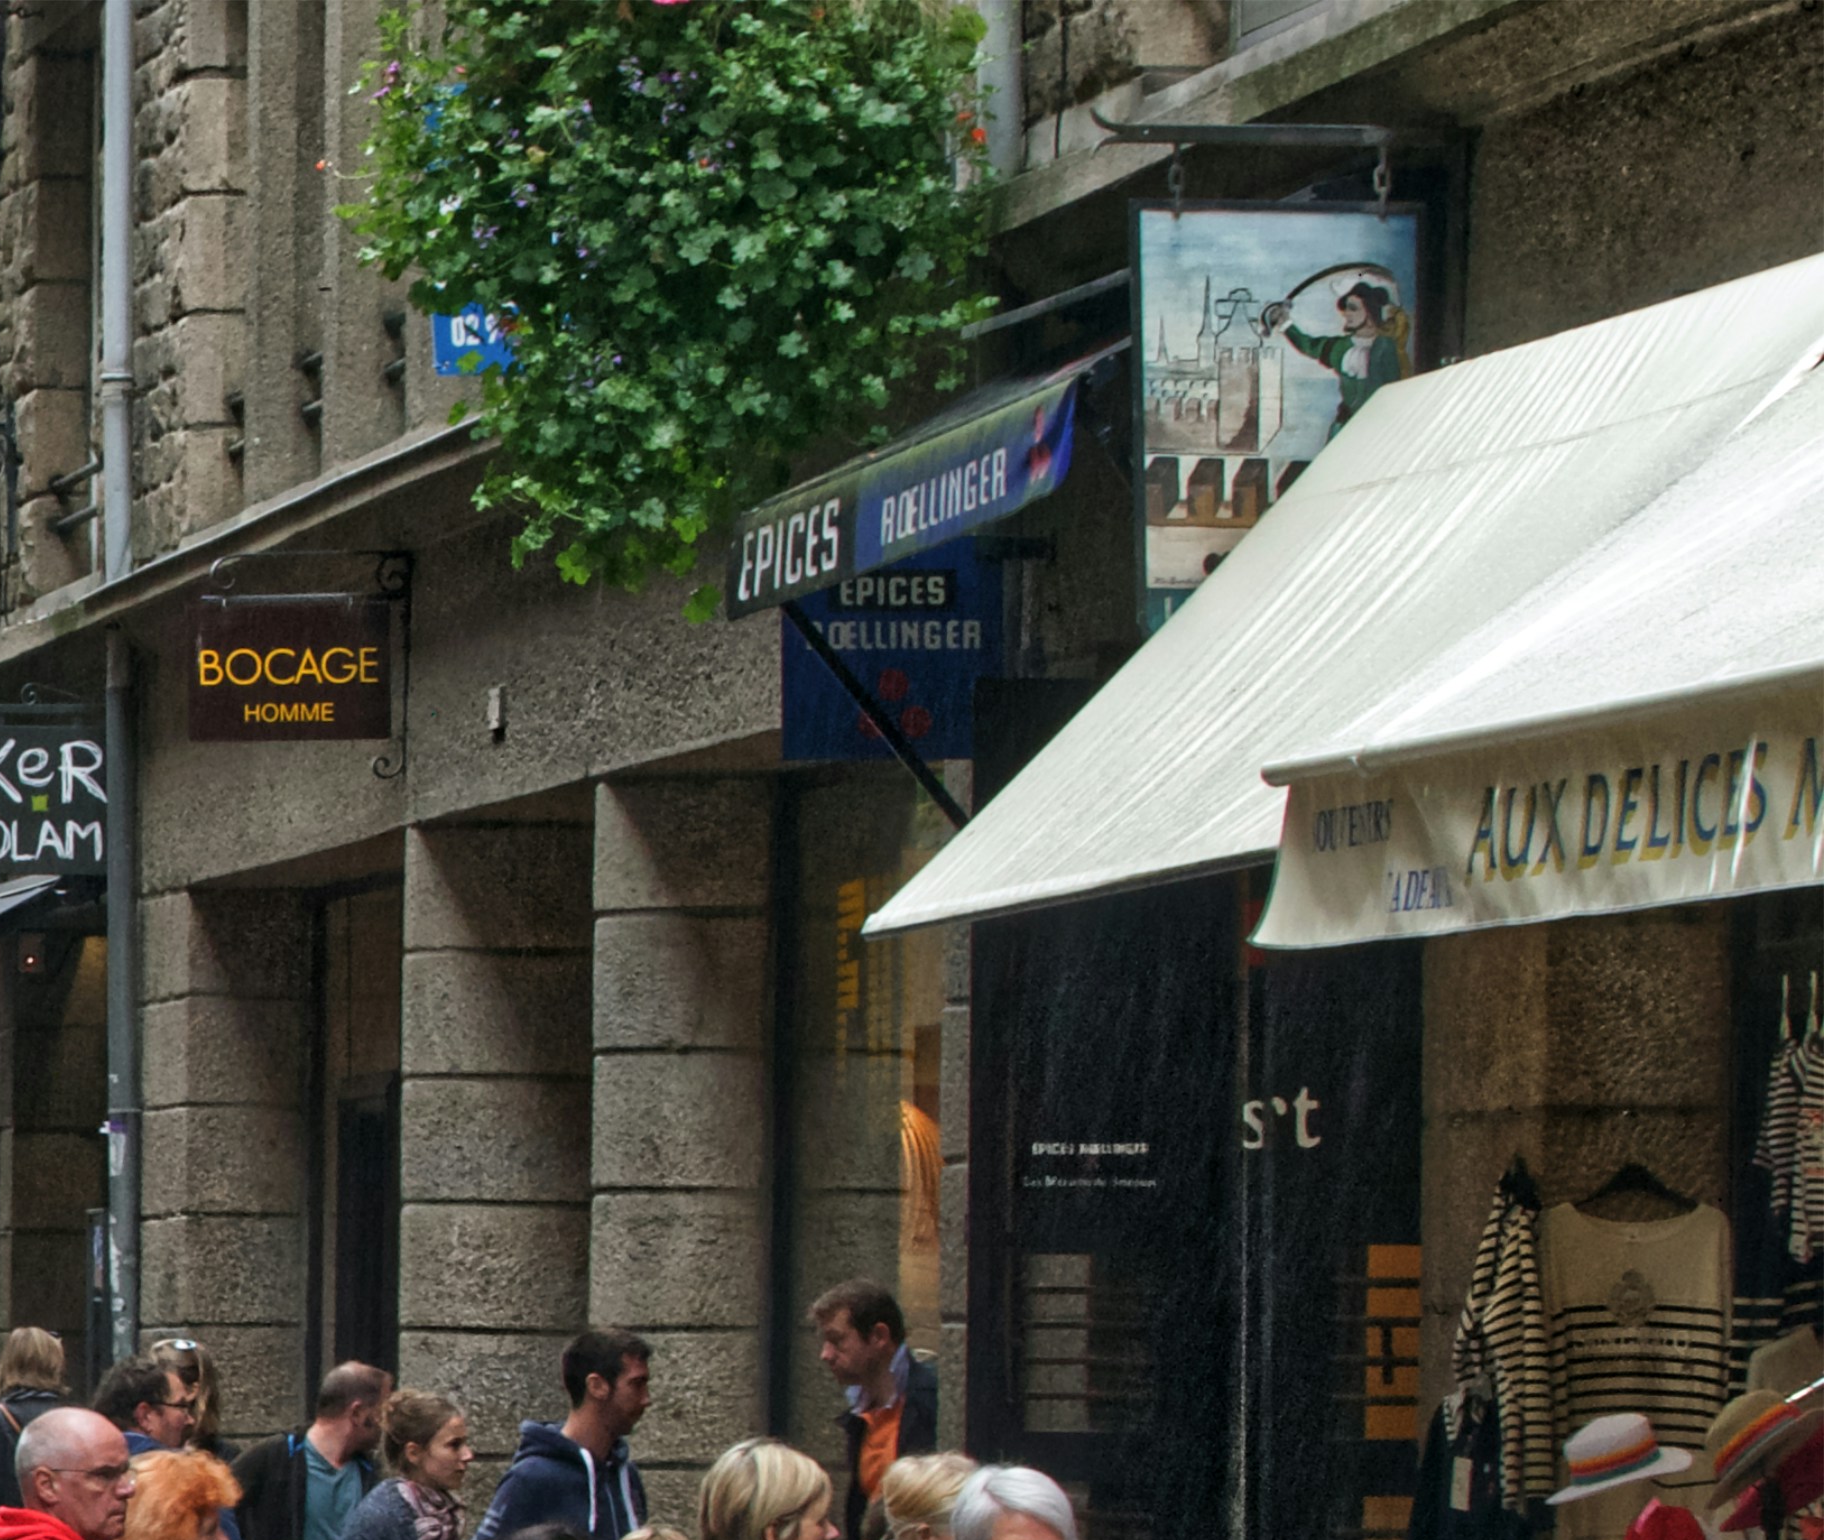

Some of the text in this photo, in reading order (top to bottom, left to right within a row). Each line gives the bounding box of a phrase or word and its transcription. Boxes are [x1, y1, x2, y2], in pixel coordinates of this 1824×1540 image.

[738, 498, 840, 602] EPICES
[840, 577, 945, 605] EPICES
[199, 647, 380, 686] BOCAGE
[244, 702, 335, 723] HOMME
[1465, 774, 1566, 885] AUX
